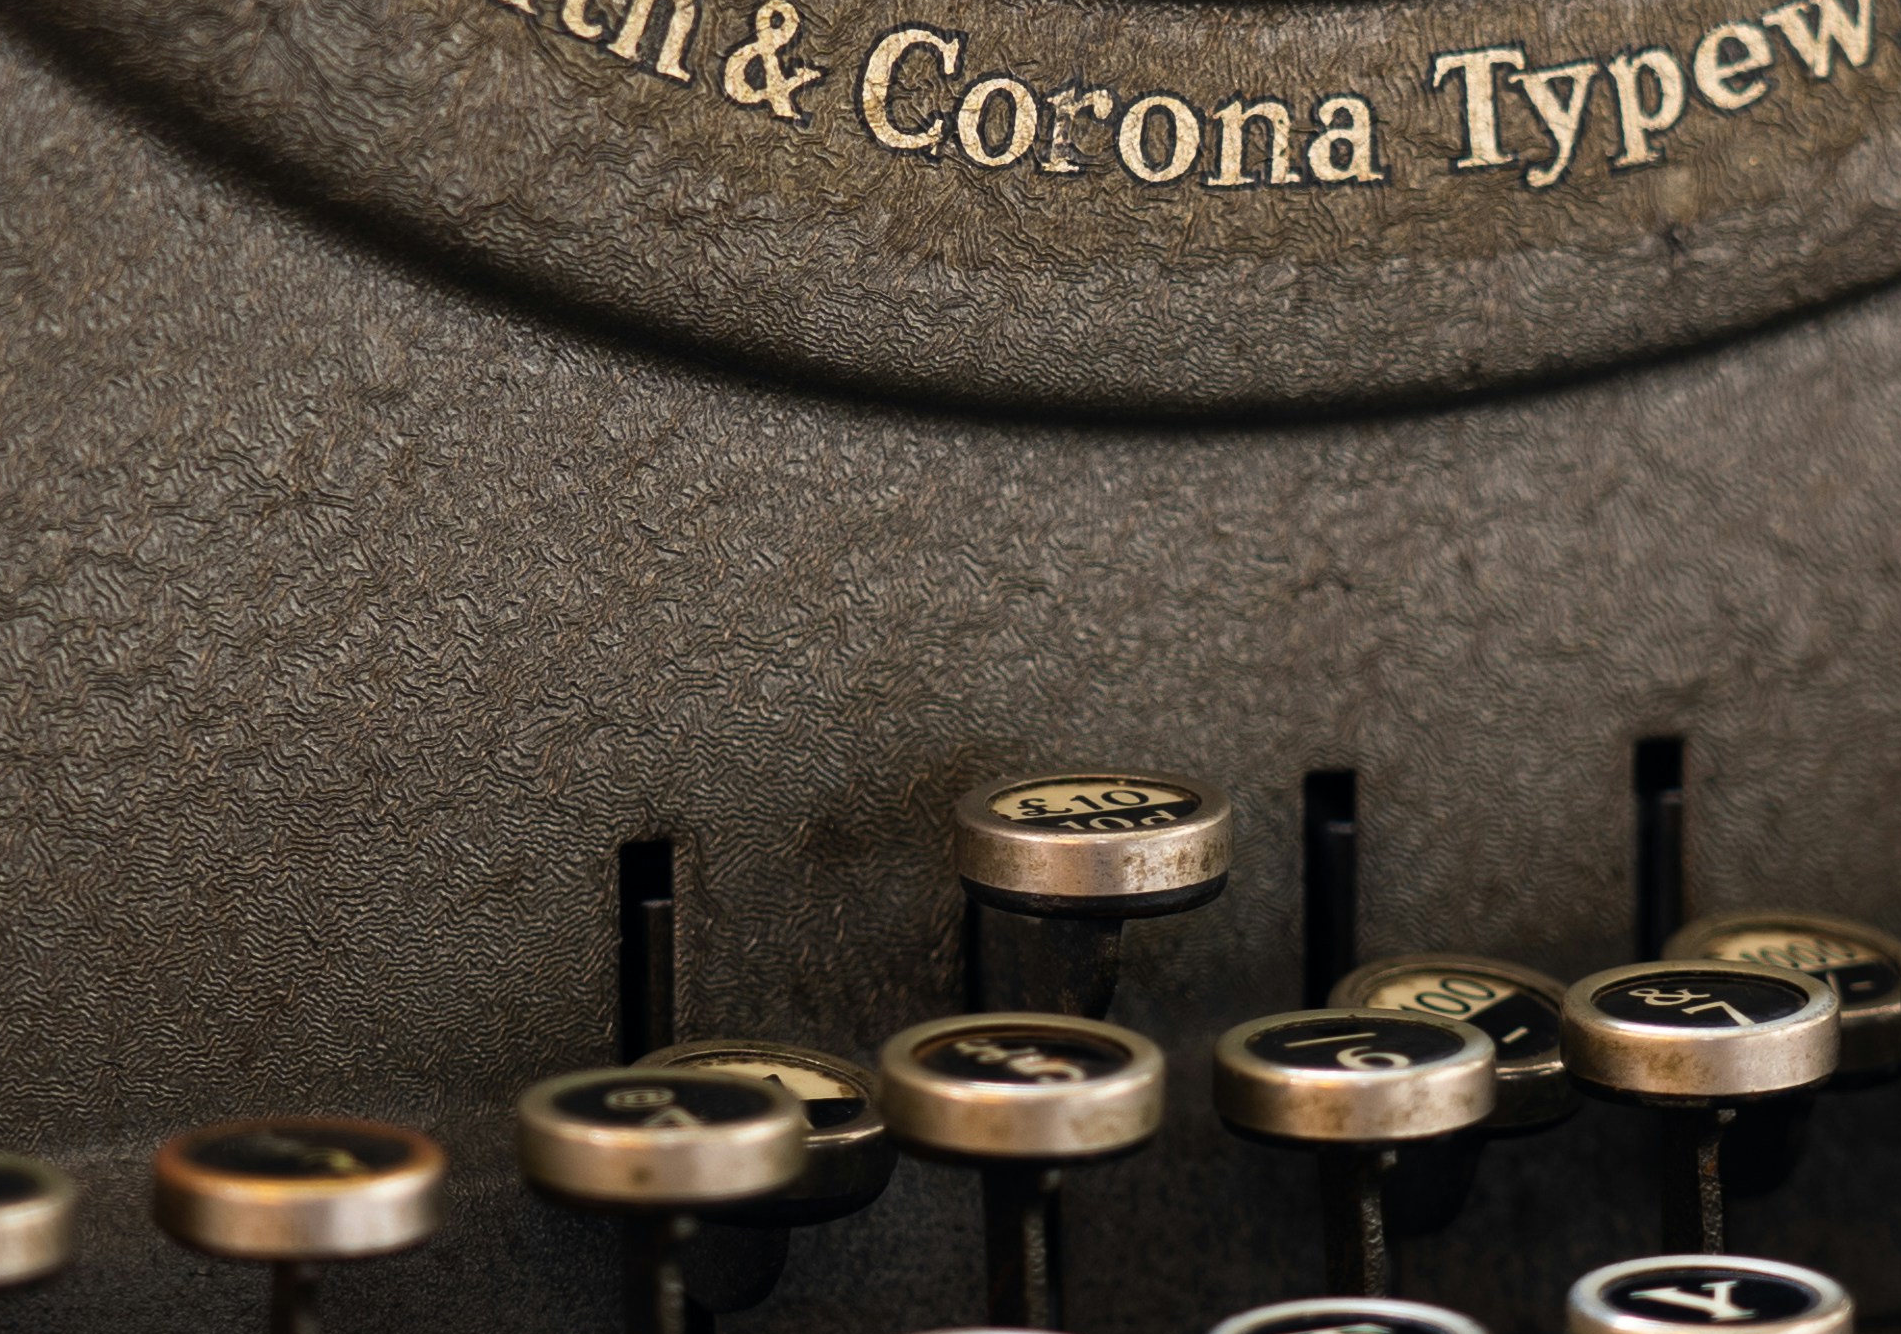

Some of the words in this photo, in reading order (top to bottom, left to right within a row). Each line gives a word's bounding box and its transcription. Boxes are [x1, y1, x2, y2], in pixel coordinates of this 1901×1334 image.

[862, 27, 1385, 187] Corona
[1628, 988, 1712, 1008] &
[1627, 1281, 1757, 1323] Y
